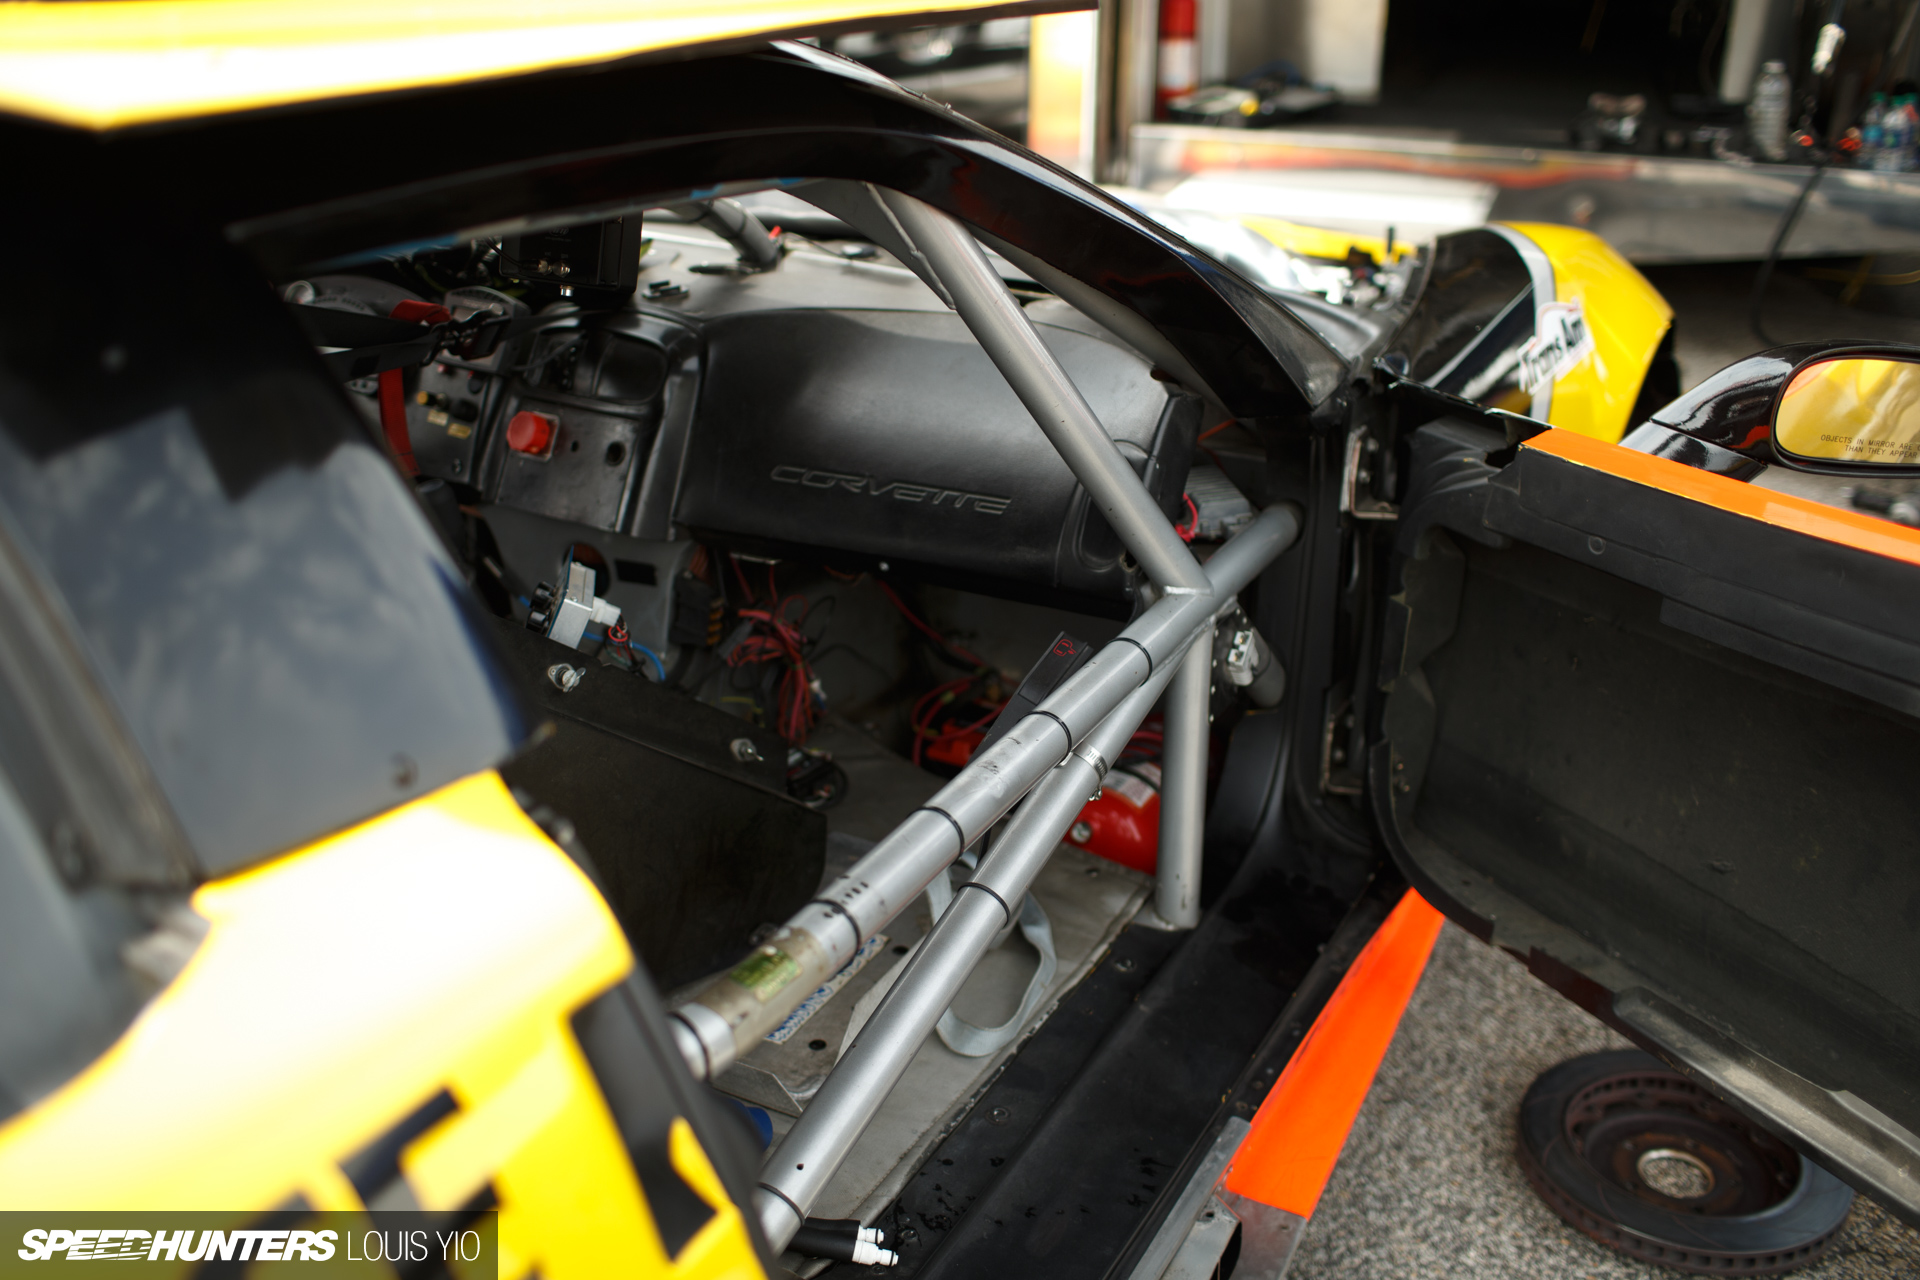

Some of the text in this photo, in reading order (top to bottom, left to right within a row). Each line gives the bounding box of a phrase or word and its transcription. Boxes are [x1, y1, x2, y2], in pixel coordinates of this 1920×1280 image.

[1820, 434, 1853, 445] OBJECTS
[1856, 438, 1864, 446] IN
[1868, 439, 1896, 449] MIRROR
[1899, 442, 1913, 451] ARE
[1845, 444, 1918, 459] THAN THEY APPEAR
[770, 464, 1012, 515] CORVETTE
